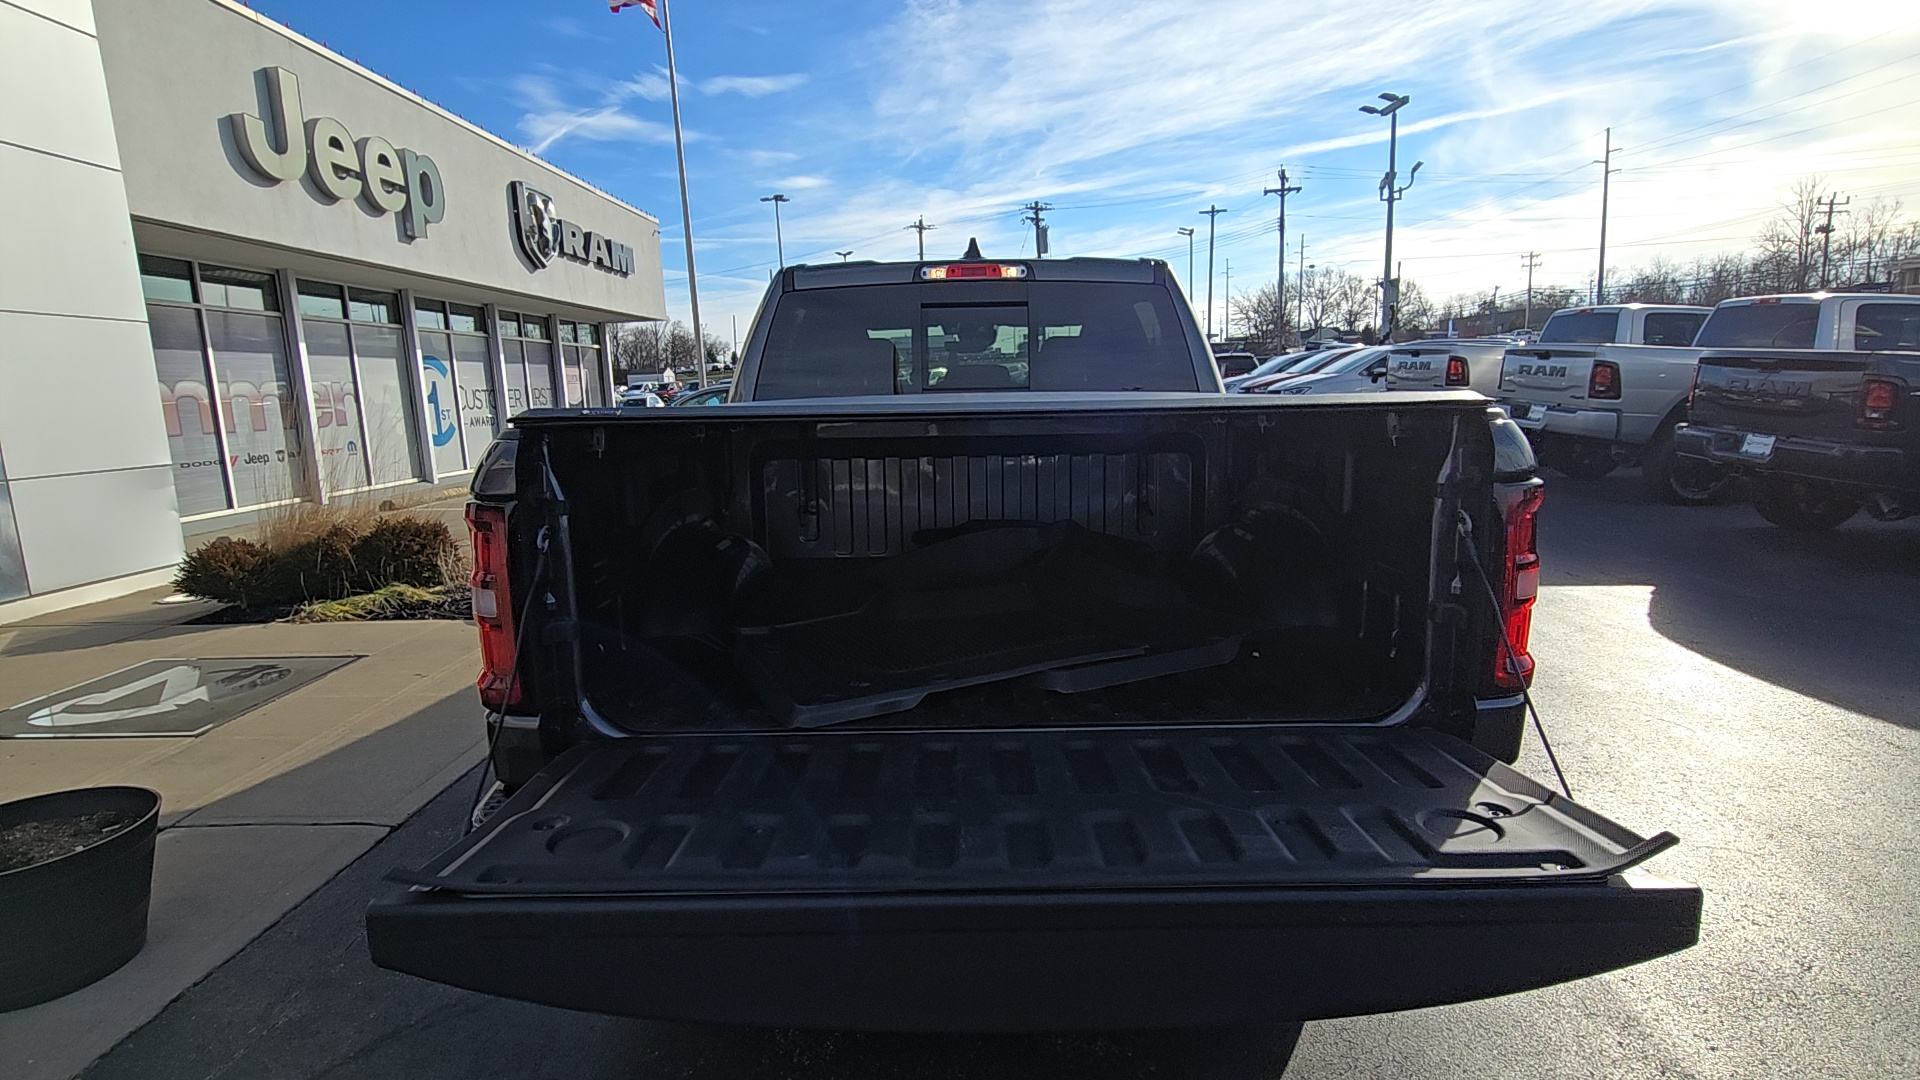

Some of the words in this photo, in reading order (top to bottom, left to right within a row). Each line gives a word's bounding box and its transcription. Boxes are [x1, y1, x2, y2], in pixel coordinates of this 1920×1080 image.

[220, 66, 446, 243] Jeep
[561, 218, 636, 277] RAM
[1398, 360, 1432, 371] RAM
[1518, 364, 1567, 378] RAM
[1727, 378, 1813, 398] RAM
[459, 384, 524, 412] CUSTOER
[469, 415, 496, 429] AWARD
[244, 452, 270, 465] Jeep
